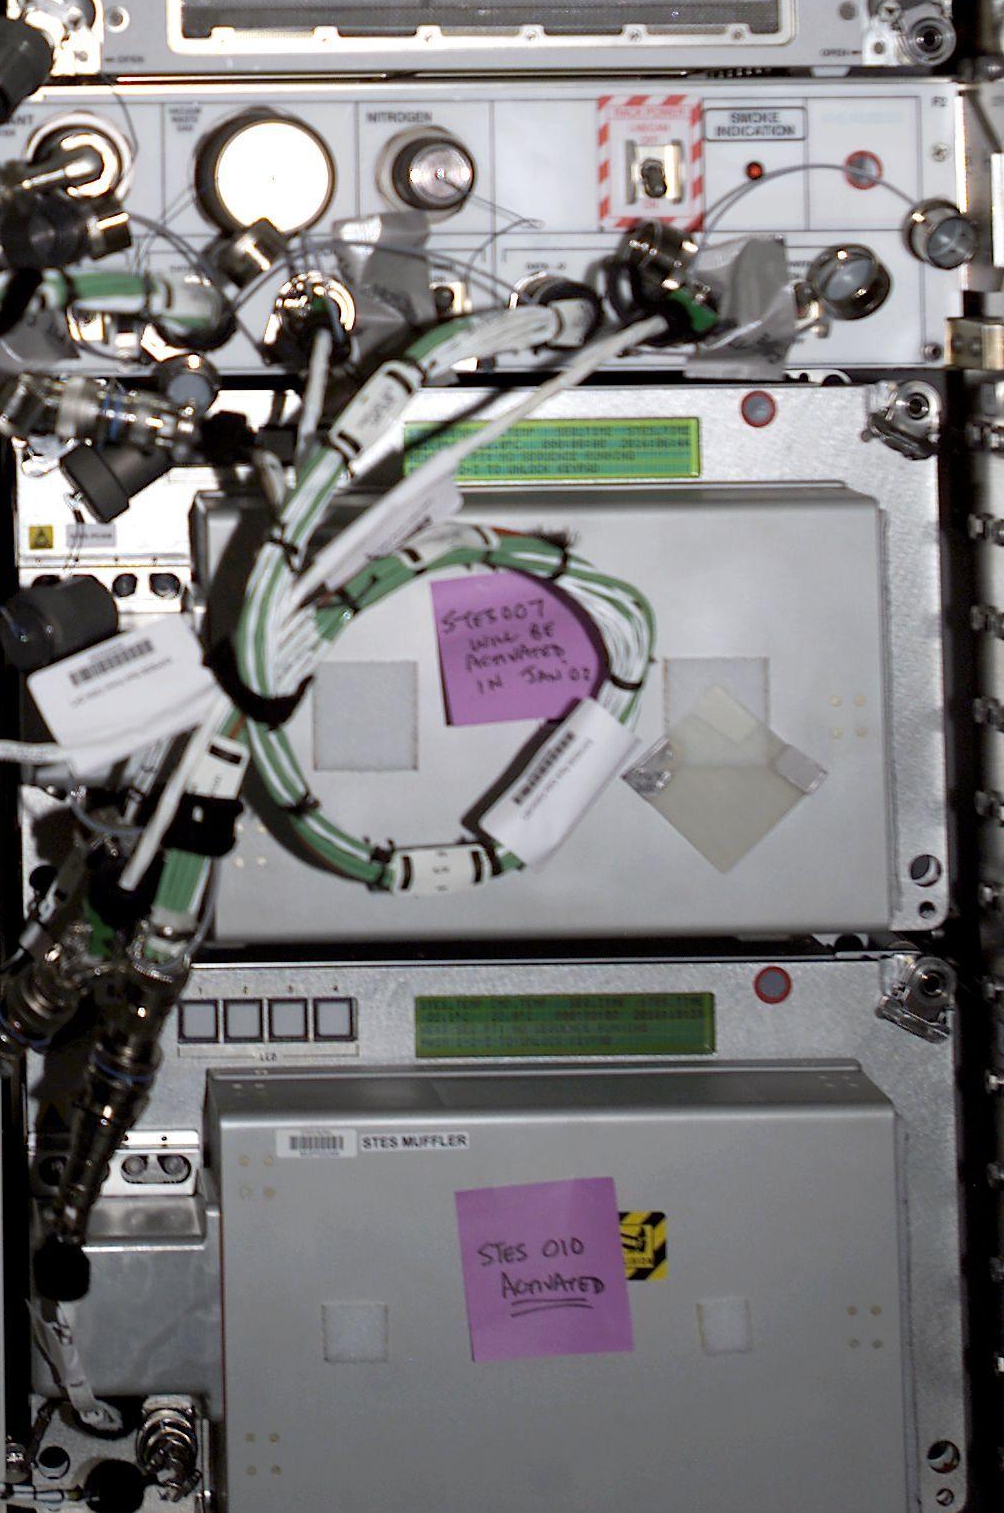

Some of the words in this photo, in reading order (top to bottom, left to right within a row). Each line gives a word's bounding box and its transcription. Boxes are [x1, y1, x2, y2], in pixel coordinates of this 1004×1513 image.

[365, 111, 434, 124] NITROGEN
[730, 111, 780, 123] SMOKE
[714, 124, 795, 137] INDICATION
[529, 620, 556, 641] BE
[361, 1135, 398, 1151] STES
[401, 1133, 467, 1150] MUFFLER
[542, 1237, 587, 1259] 010
